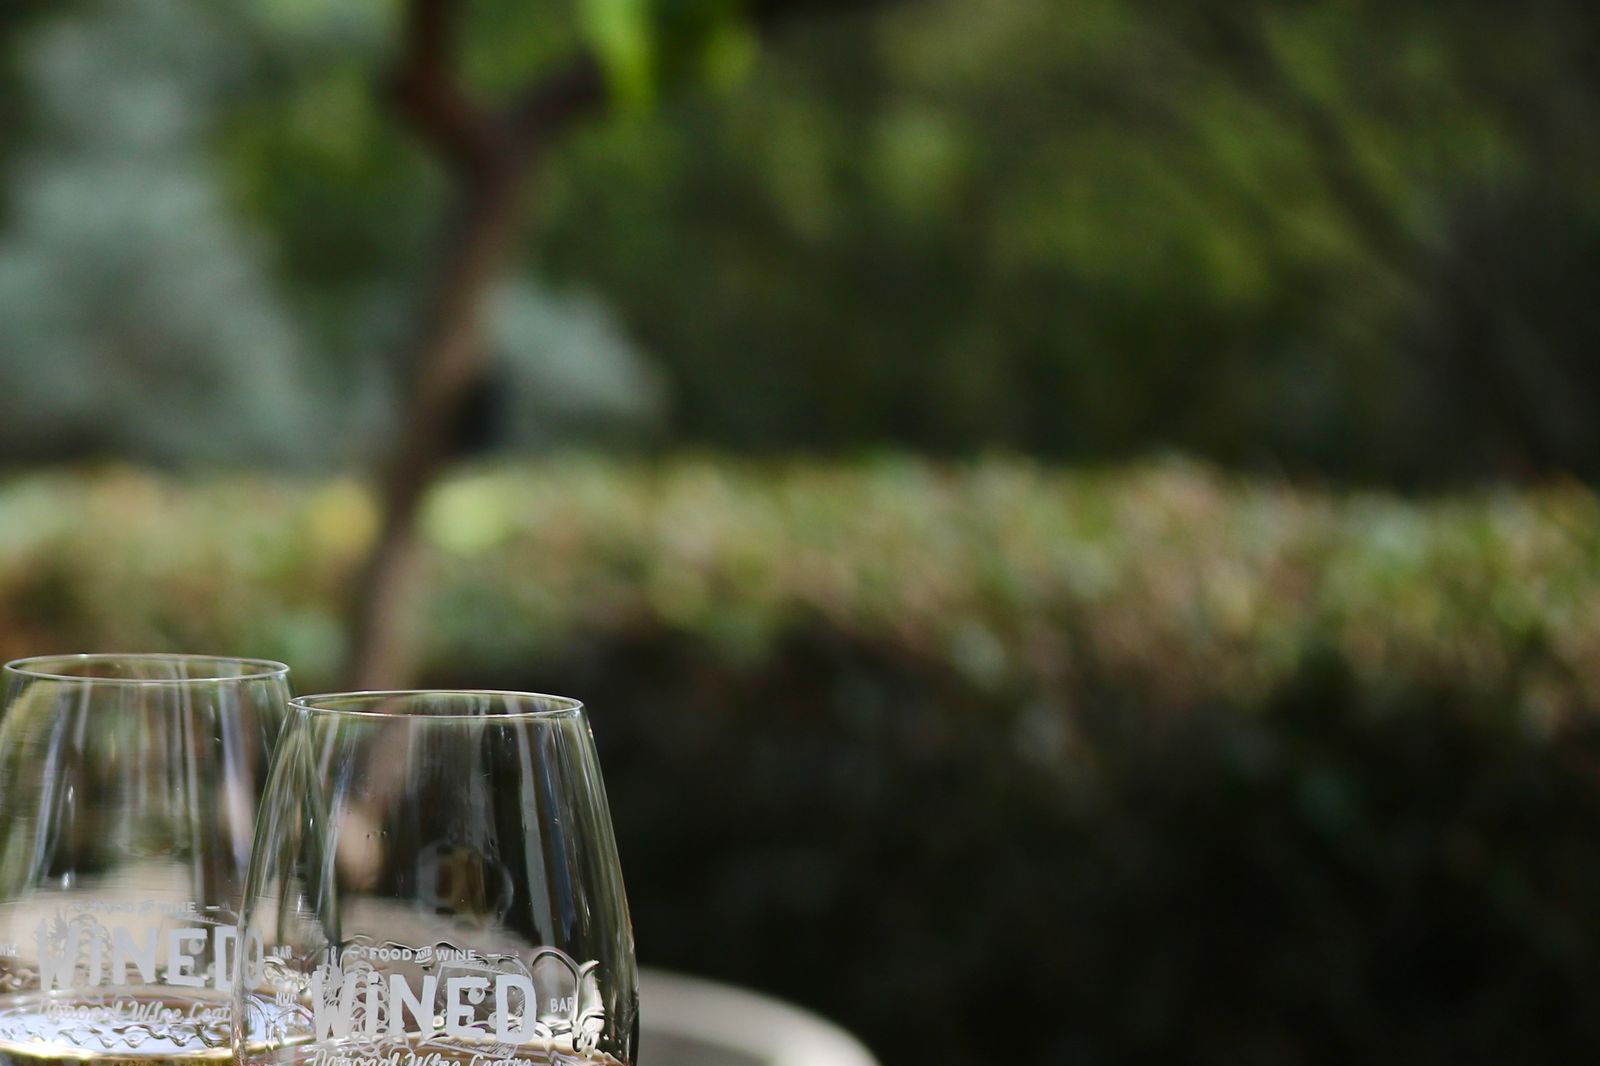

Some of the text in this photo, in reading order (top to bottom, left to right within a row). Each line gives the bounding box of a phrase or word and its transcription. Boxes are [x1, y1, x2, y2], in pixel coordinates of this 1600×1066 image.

[35, 924, 264, 991] WINED
[369, 945, 477, 963] FOOD AND WINE
[311, 970, 536, 1045] WINED
